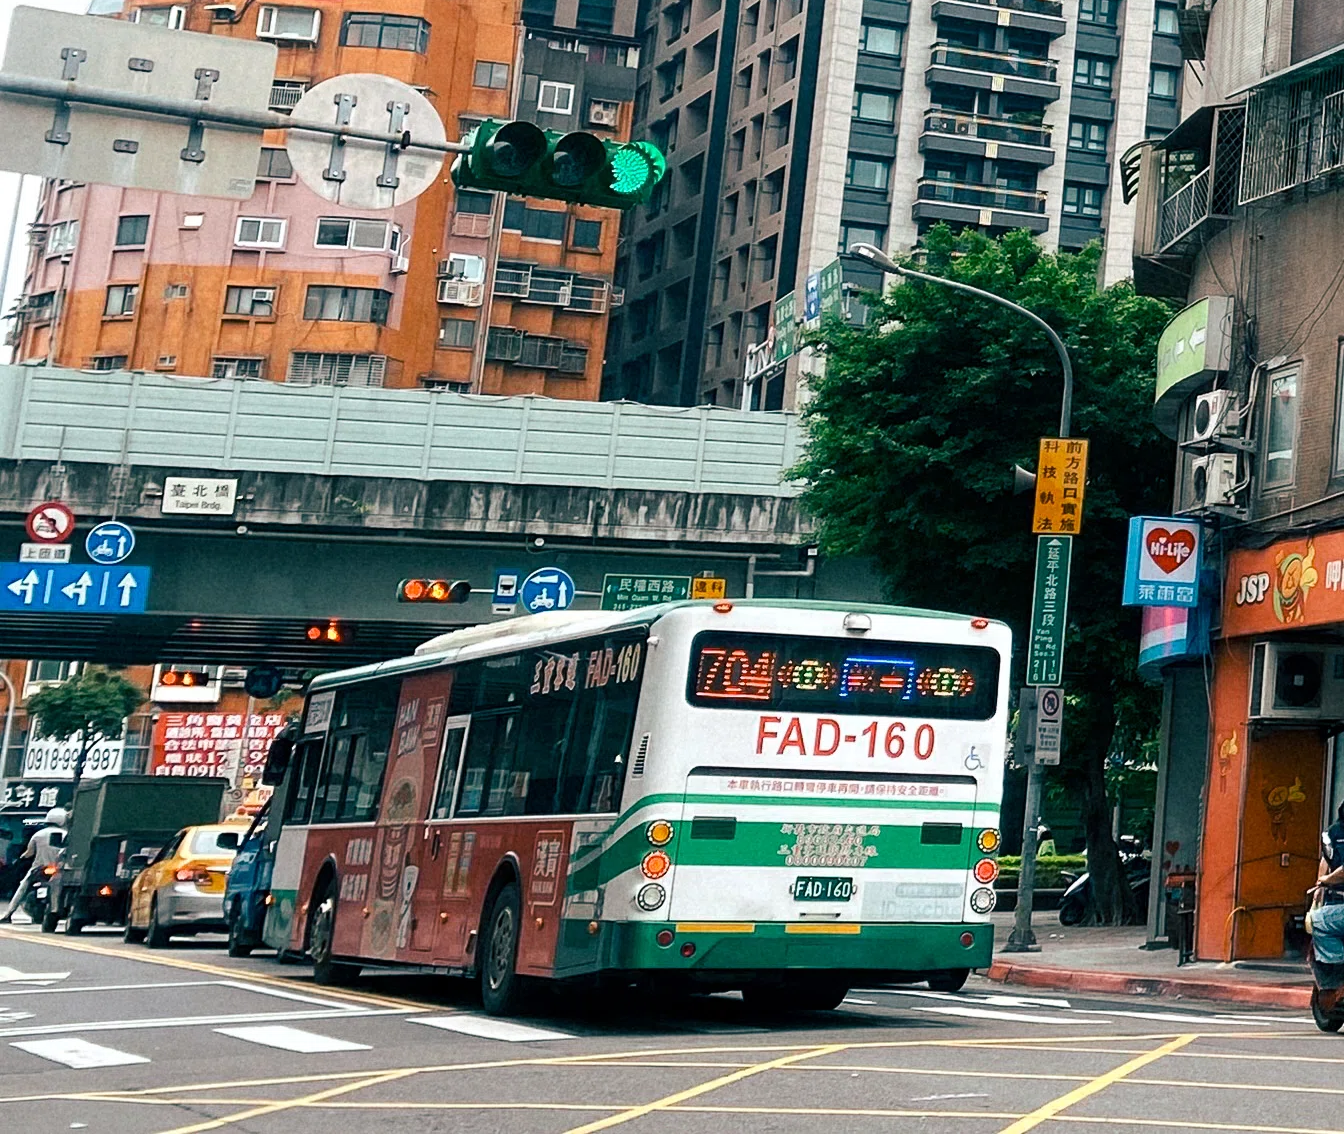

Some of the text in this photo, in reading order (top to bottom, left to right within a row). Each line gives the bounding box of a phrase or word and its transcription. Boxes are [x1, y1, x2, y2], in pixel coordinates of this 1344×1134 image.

[1036, 440, 1060, 531] 科技執法
[1059, 441, 1083, 532] 前方路口實施
[1150, 536, 1190, 564] Hi-Life
[619, 578, 674, 593] 民權西路
[1041, 546, 1060, 627] 延平北路三段
[1138, 584, 1193, 603] 萊爾富
[1235, 573, 1270, 606] JSP
[584, 642, 641, 690] FAD-160
[698, 648, 774, 698] 704
[755, 716, 935, 760] FAD-160
